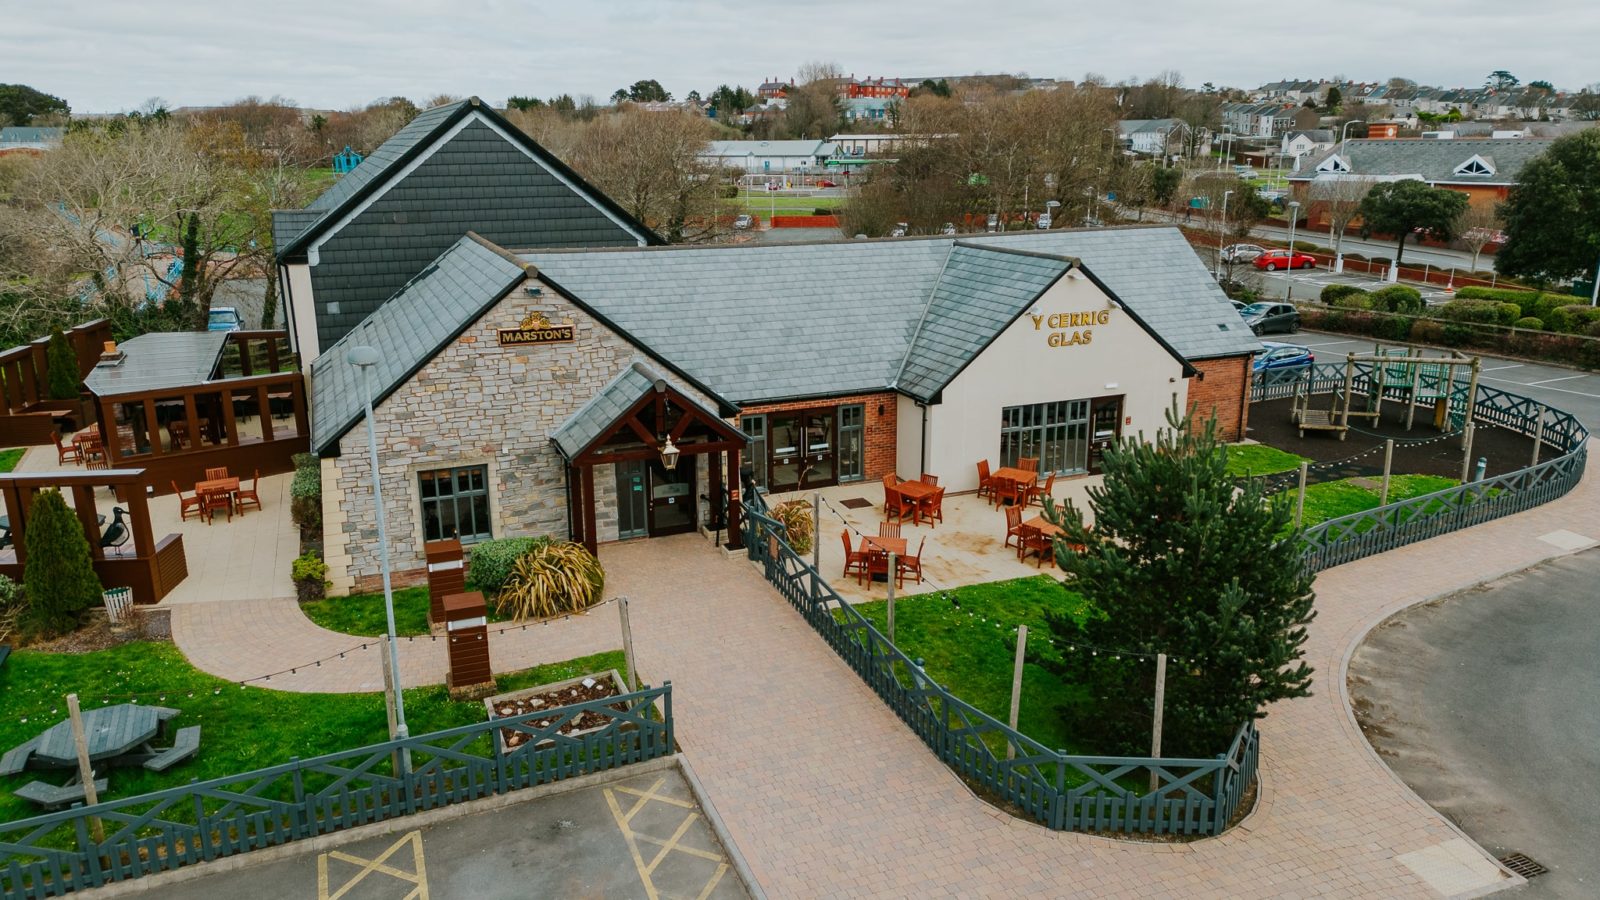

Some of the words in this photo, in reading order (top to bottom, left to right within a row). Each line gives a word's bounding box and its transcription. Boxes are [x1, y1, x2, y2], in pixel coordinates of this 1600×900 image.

[1032, 315, 1043, 330] Y
[1048, 310, 1109, 328] CERRIG
[502, 329, 571, 342] MARSTON'S
[1047, 330, 1092, 347] GLAS
